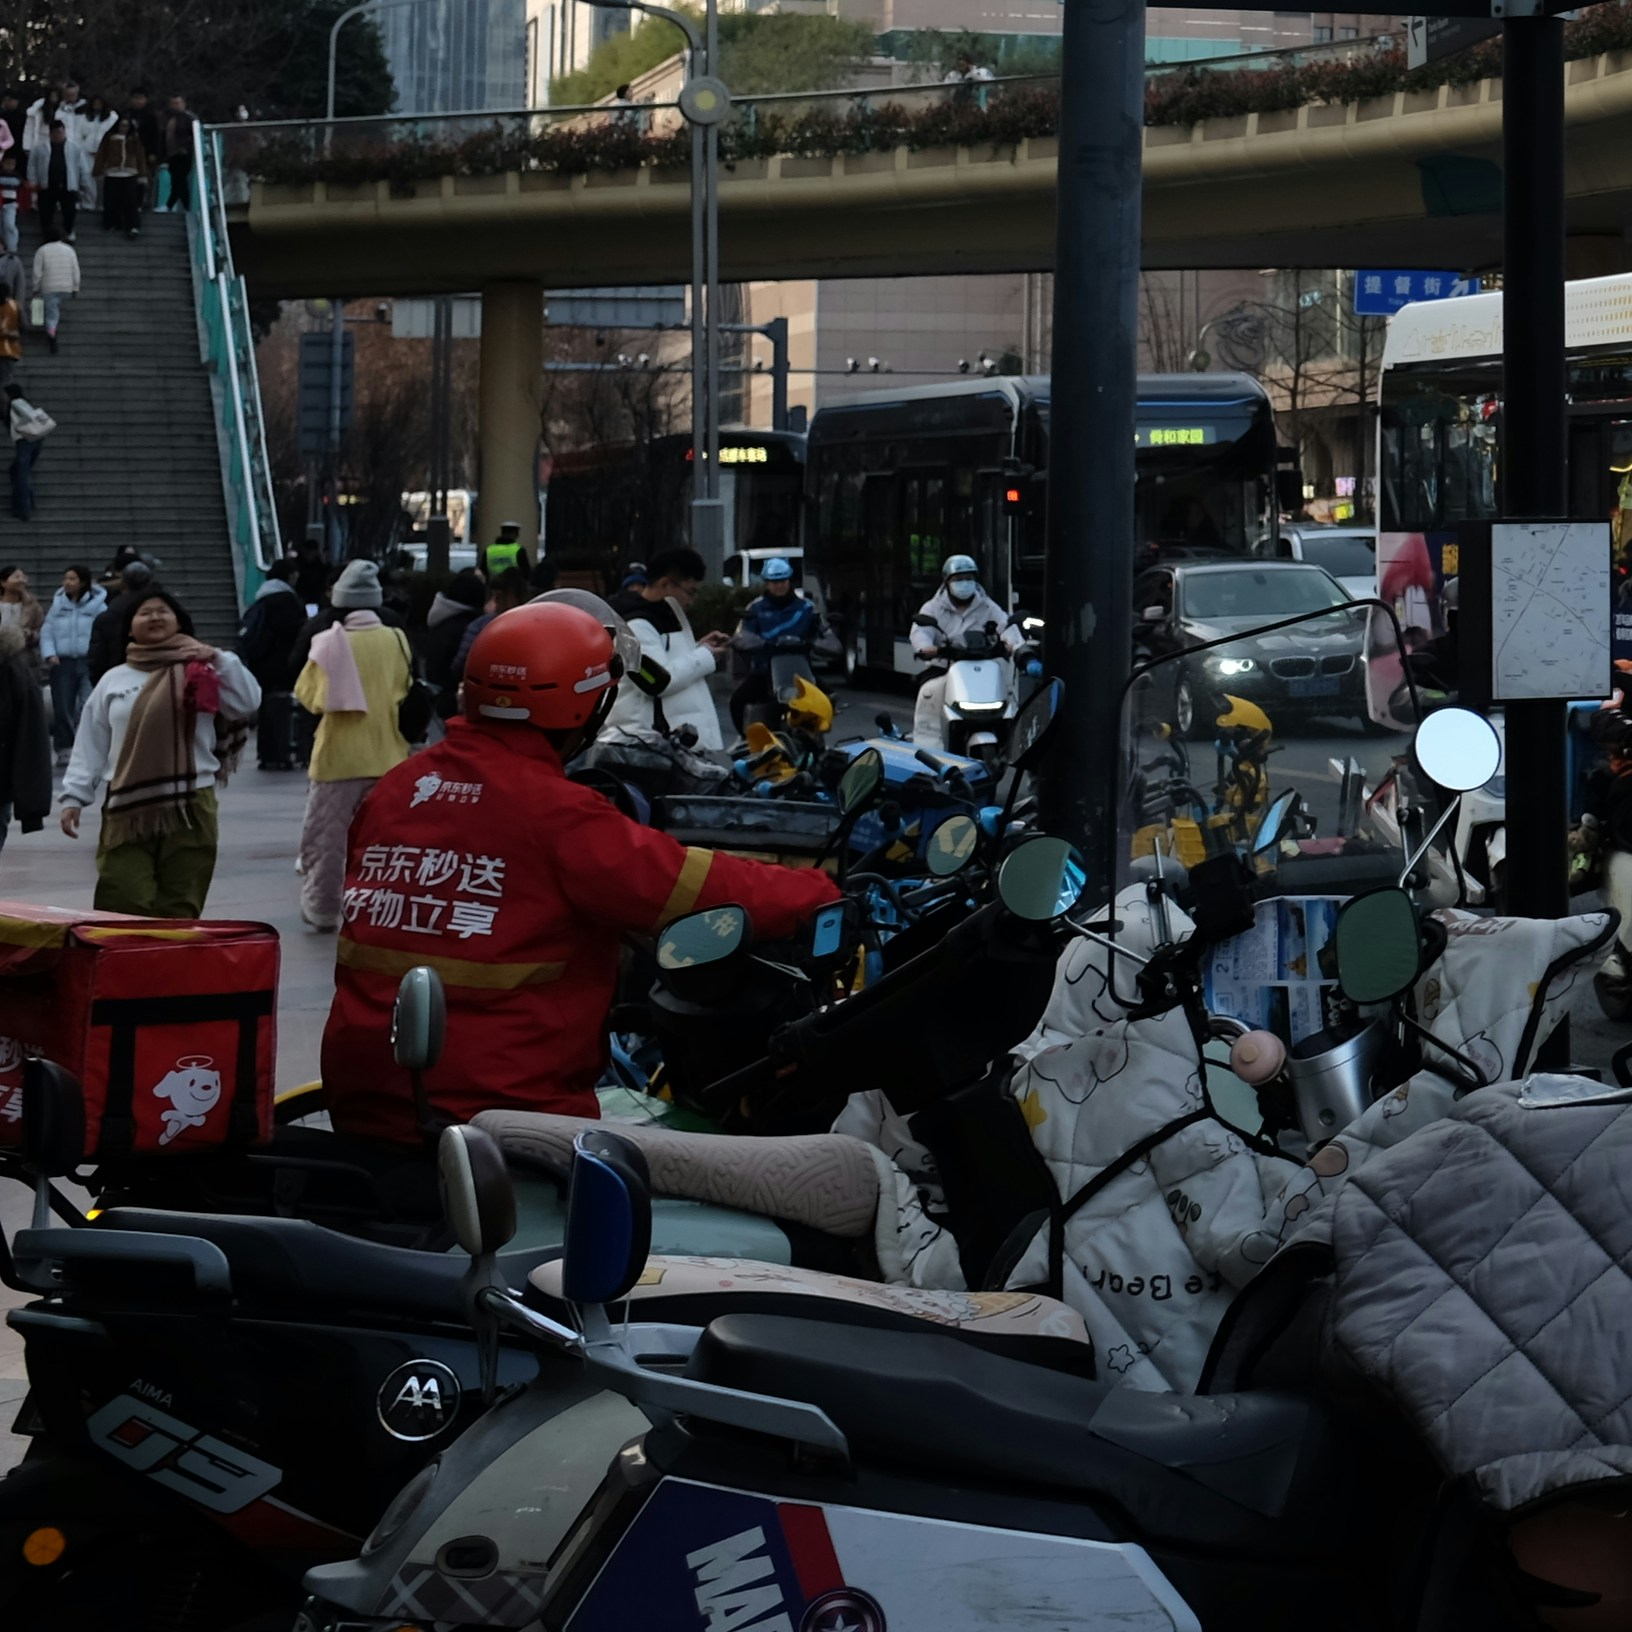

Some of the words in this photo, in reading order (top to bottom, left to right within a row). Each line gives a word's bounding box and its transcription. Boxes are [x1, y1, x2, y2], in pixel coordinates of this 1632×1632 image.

[1364, 275, 1441, 296] 提督街
[440, 780, 484, 796] 京东秒送
[357, 843, 507, 899] 京东秒送
[341, 886, 501, 941] 好物立享
[128, 1376, 174, 1410] AIMA
